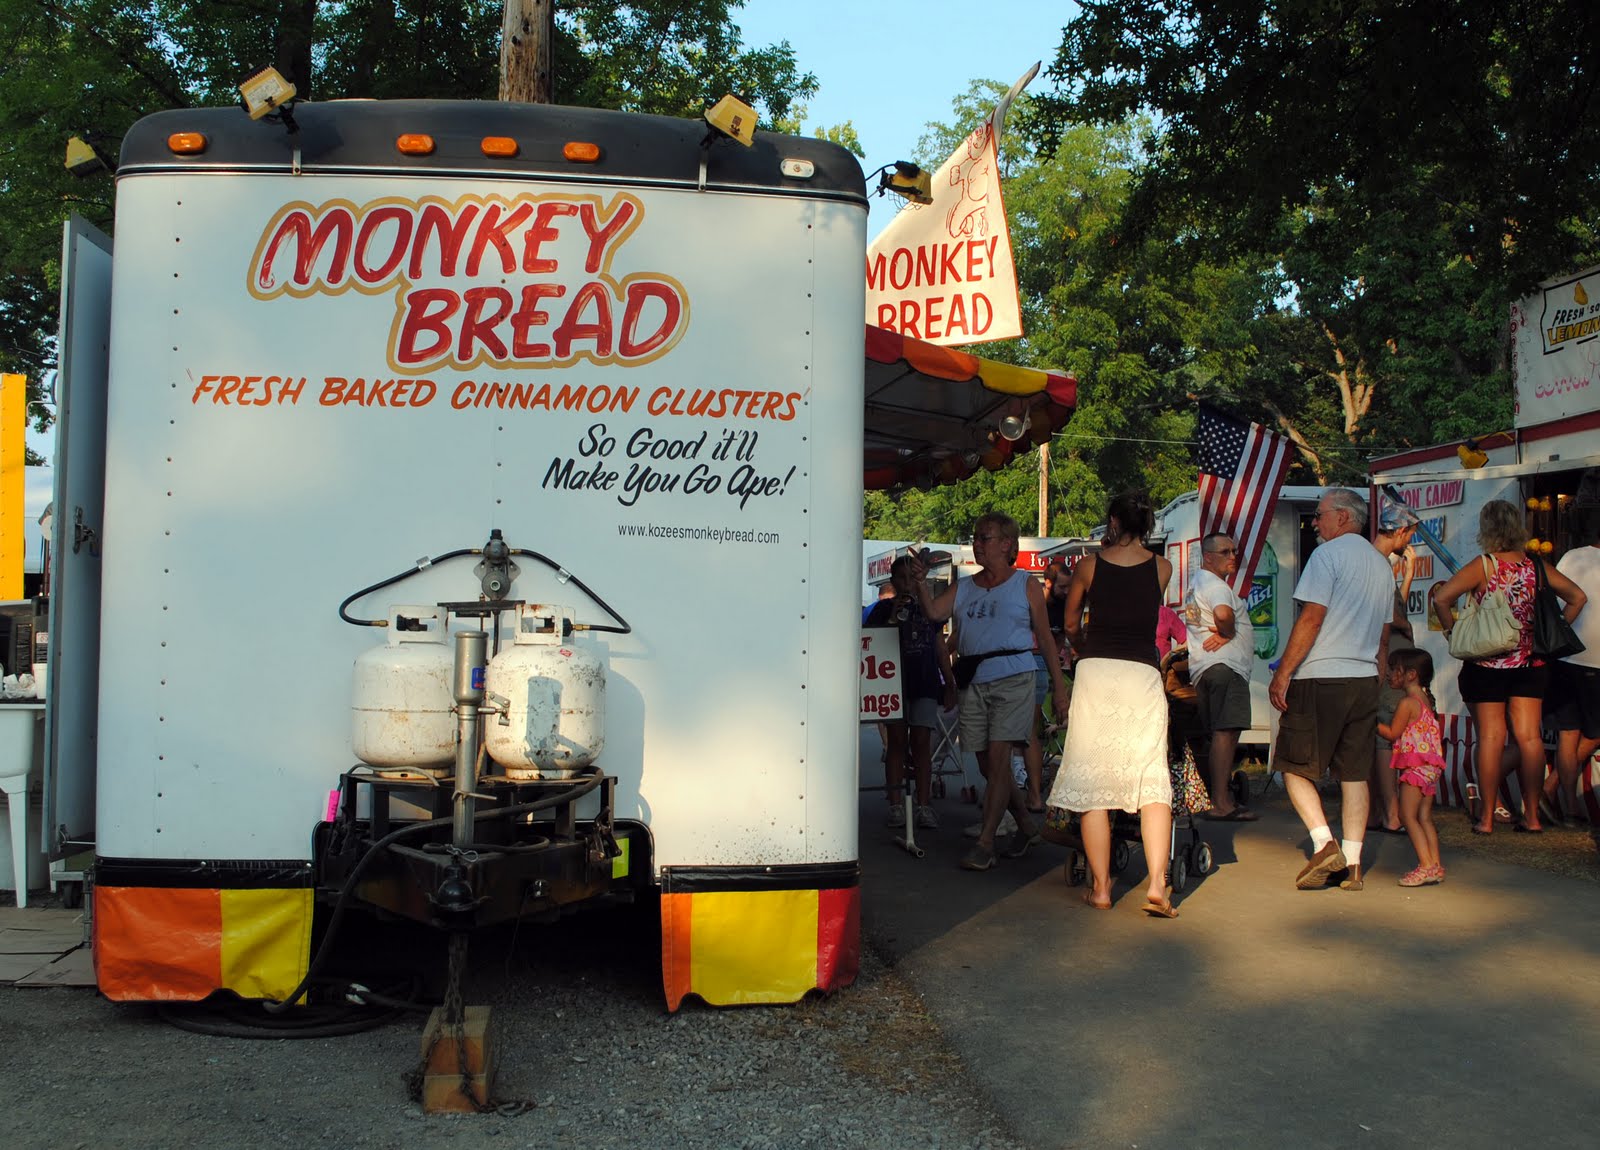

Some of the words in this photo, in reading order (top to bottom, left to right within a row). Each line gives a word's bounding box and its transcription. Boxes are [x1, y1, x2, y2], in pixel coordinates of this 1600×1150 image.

[260, 201, 634, 288] MONKEY
[867, 236, 998, 291] MONKEY
[399, 281, 681, 363] BREAD
[878, 292, 993, 339] BREAD
[1552, 307, 1585, 327] FRESH
[192, 375, 306, 406] FRESH
[319, 377, 437, 407] BAKED
[451, 380, 640, 413] CINNAMON
[647, 386, 801, 421] CLUSTERS
[578, 423, 616, 457] So
[626, 427, 707, 461] Good
[542, 457, 619, 491] Make
[617, 462, 680, 507] You
[683, 463, 721, 495] Go
[727, 464, 796, 511] Ape!
[1426, 480, 1463, 508] CANDY
[618, 522, 780, 545] www.kozeesmonkeybread.com
[861, 655, 896, 680] le
[860, 693, 900, 718] ngs
